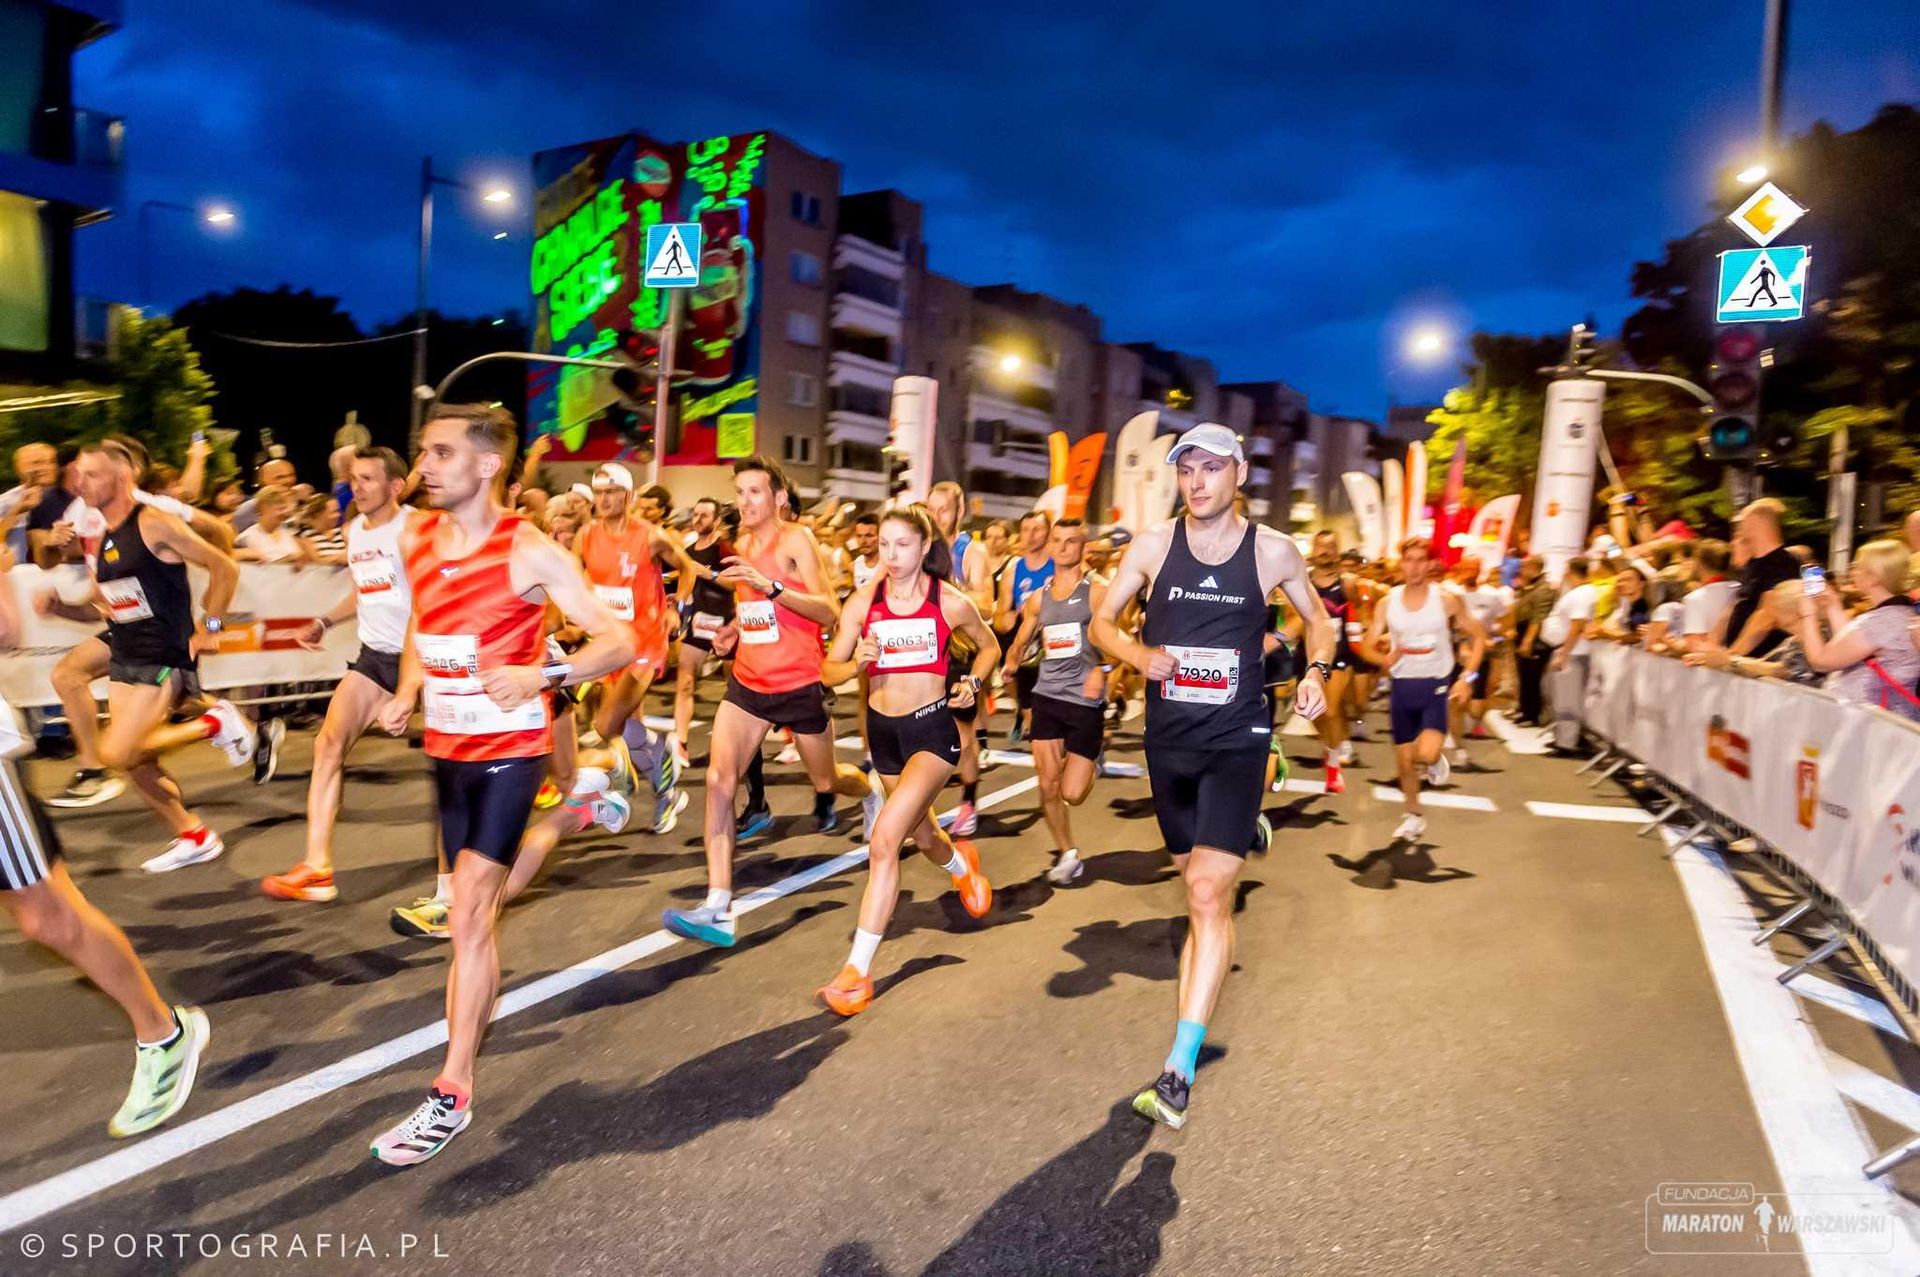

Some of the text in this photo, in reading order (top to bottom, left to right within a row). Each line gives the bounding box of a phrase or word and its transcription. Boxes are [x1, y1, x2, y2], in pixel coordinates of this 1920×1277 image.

[1184, 591, 1221, 602] PASSION
[1221, 595, 1246, 605] FIRST
[887, 635, 923, 648] 6063
[1180, 666, 1222, 682] 7920
[915, 703, 937, 719] NIKE
